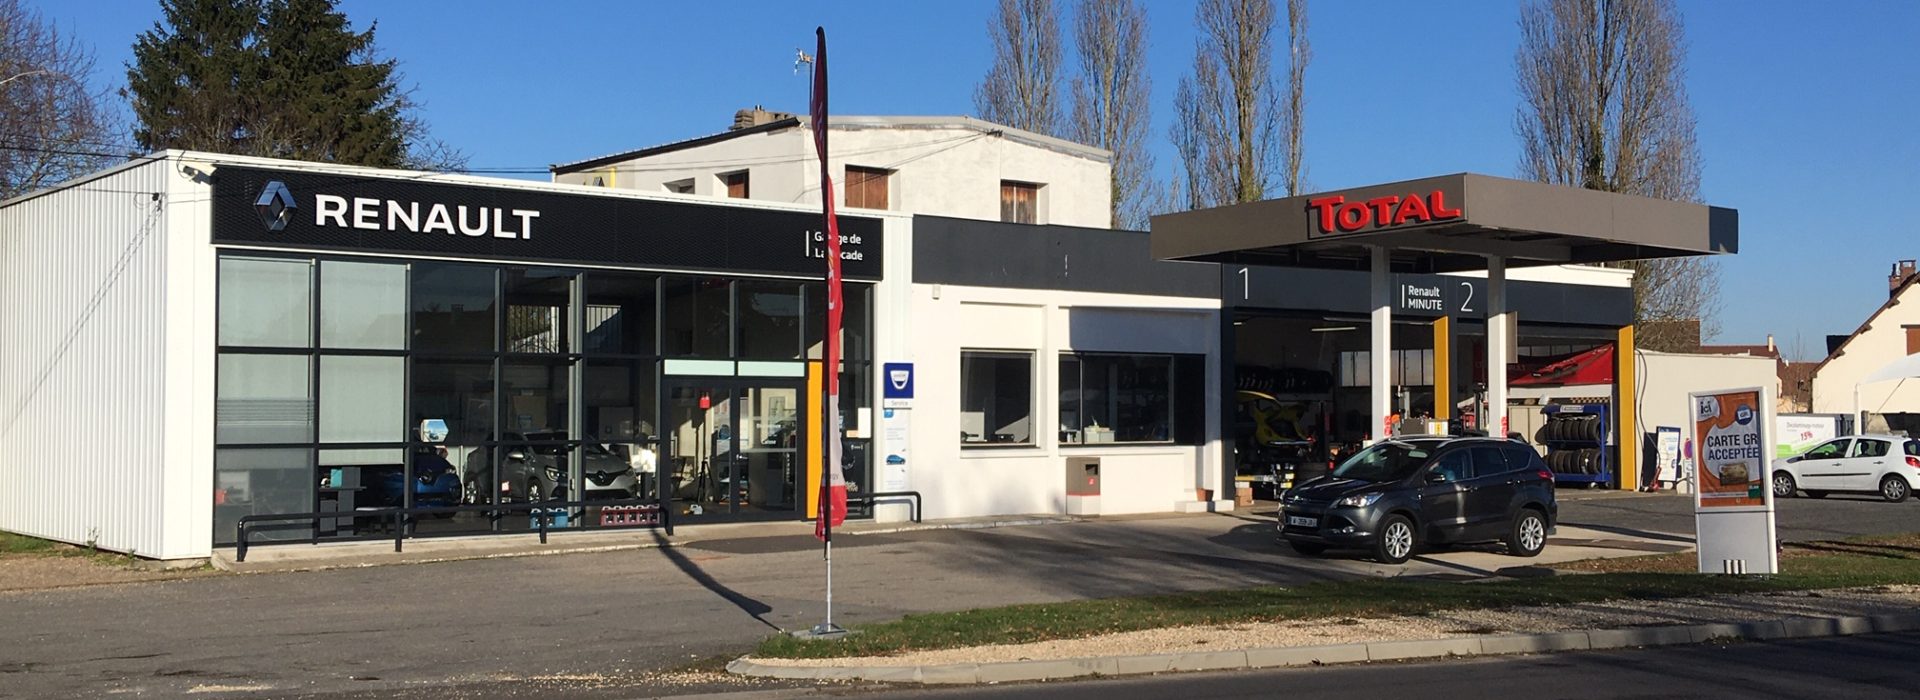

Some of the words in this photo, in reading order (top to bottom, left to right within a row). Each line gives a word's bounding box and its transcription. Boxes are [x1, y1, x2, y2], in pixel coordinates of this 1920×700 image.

[315, 193, 540, 240] RENAULT
[1310, 191, 1461, 232] TOTAL
[814, 231, 848, 246] Gge
[849, 233, 862, 245] de
[837, 250, 863, 261] cade
[1238, 267, 1249, 300] 1
[1408, 284, 1440, 298] Renault
[1408, 299, 1443, 310] MINUTE
[1460, 282, 1474, 312] 2
[1707, 434, 1741, 448] CARTE
[1708, 446, 1760, 461] ACCEPTÉE
